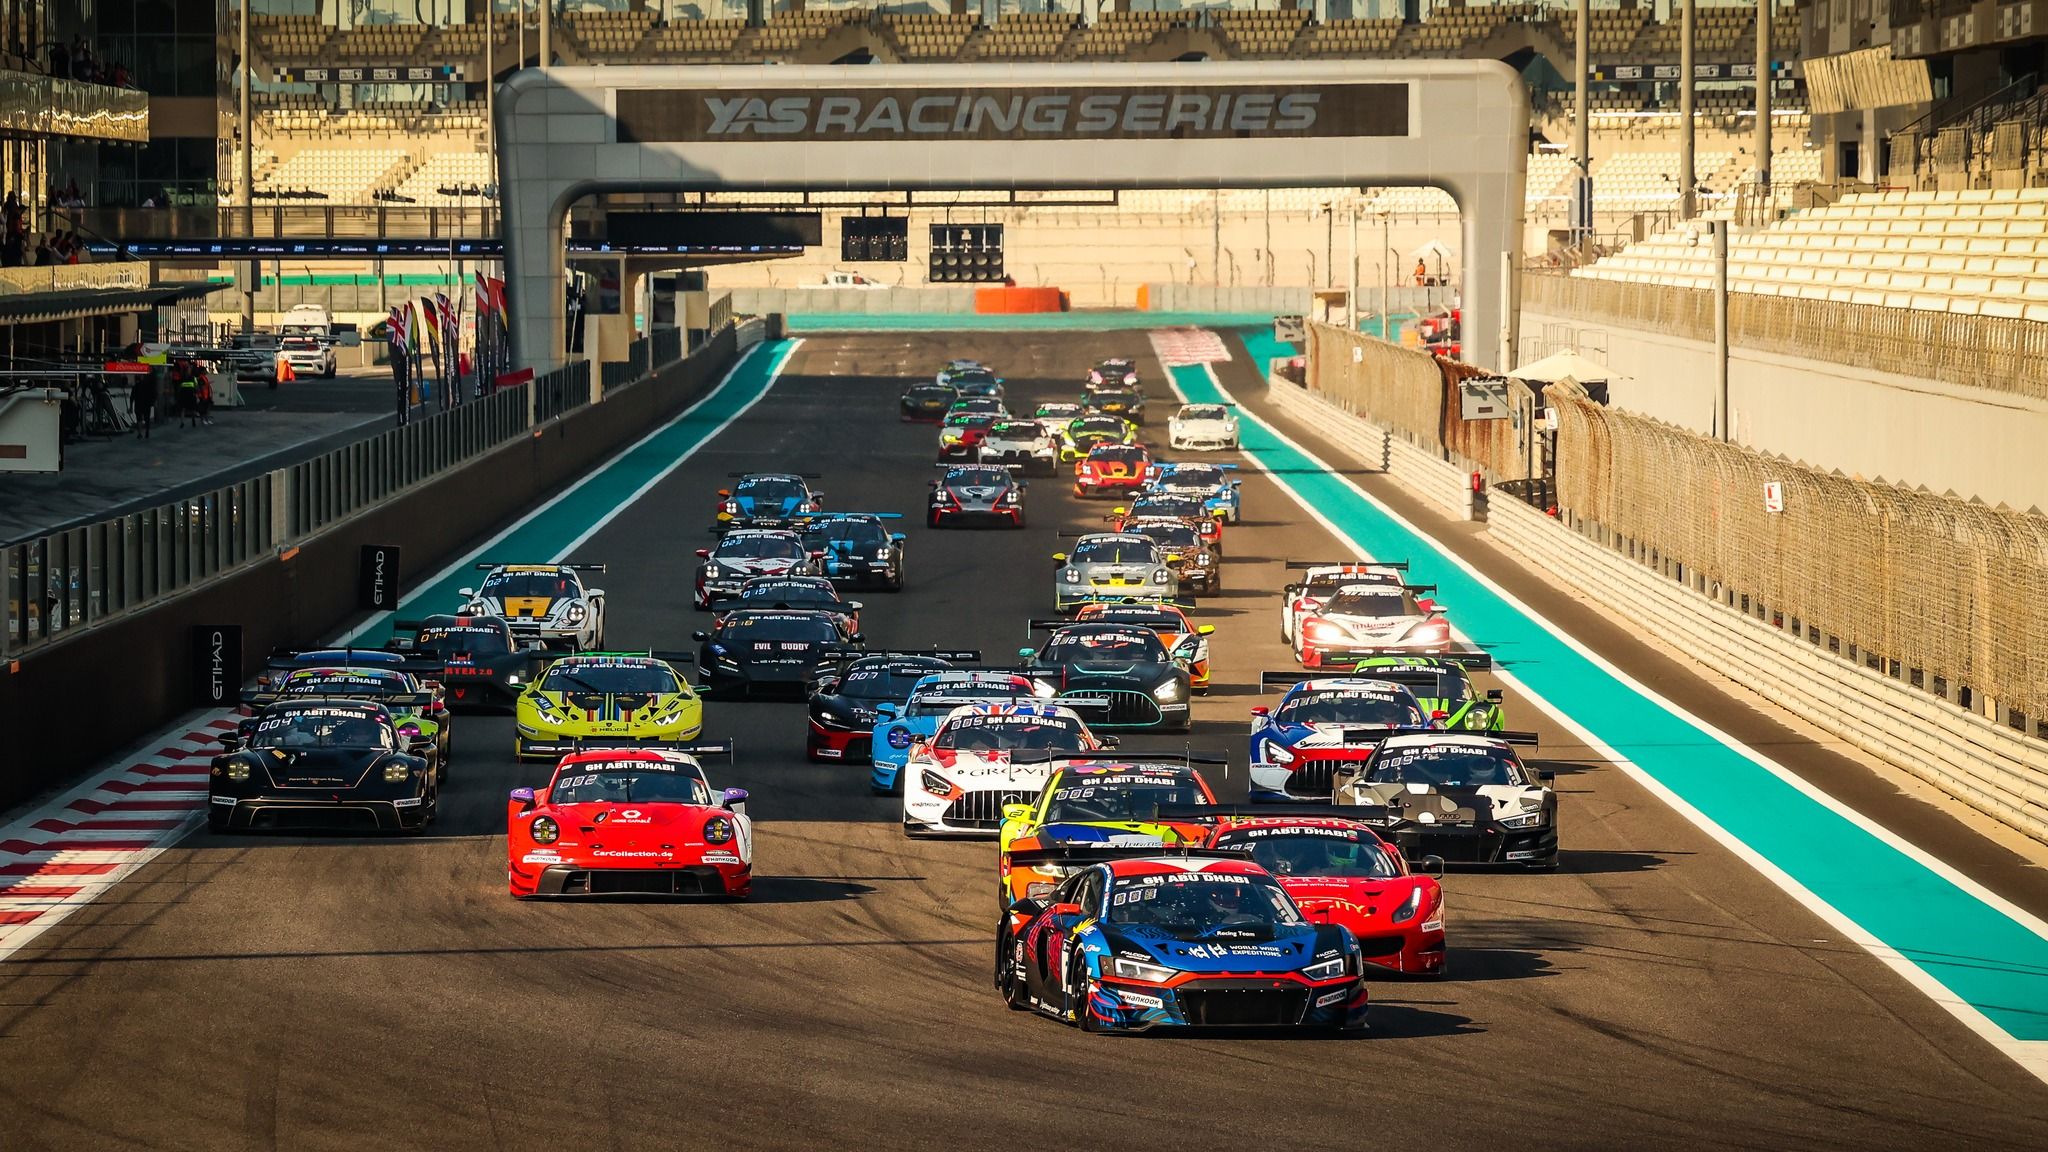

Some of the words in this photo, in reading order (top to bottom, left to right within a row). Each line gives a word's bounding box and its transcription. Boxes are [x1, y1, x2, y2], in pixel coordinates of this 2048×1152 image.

[703, 97, 811, 134] YAS
[815, 96, 1070, 133] RACING
[1077, 93, 1322, 131] SERIES
[374, 550, 384, 605] ETIHAD
[465, 626, 494, 634] DHABI
[1115, 635, 1145, 644] DHABI
[754, 642, 772, 650] EVIL
[781, 642, 810, 651] BUDDY
[212, 631, 223, 700] ETIHAD
[1416, 666, 1447, 674] DHABI
[348, 677, 382, 685] DHABI
[848, 672, 878, 681] 007
[977, 683, 1010, 691] DHABI
[1336, 691, 1358, 699] ABU
[1361, 692, 1394, 702] DHABI
[330, 710, 366, 719] DHABI
[258, 717, 292, 732] 004
[1005, 716, 1029, 724] ABU
[1032, 717, 1067, 729] DHABI
[1402, 748, 1420, 756] 6H
[1422, 747, 1447, 755] ABU
[1451, 748, 1487, 756] DHABI
[585, 763, 603, 771] 6H
[606, 762, 632, 770] ABU
[636, 763, 676, 772] DHABI
[1379, 756, 1413, 770] 009
[559, 775, 597, 789] 002
[1082, 777, 1100, 786] 6H
[1103, 776, 1131, 784] ABU
[1134, 776, 1176, 786] DHABI
[1056, 787, 1096, 801] 006
[1248, 829, 1267, 838] 6H
[1271, 828, 1300, 836] ABU
[1303, 828, 1347, 838] DHABI
[593, 850, 673, 858] CarCollection.de
[1143, 873, 1166, 884] 6H
[1168, 873, 1200, 883] ABU
[1202, 873, 1250, 885] DHABI
[1297, 900, 1371, 918] USCITY
[1231, 950, 1282, 958] EXPEDITIONS
[1125, 994, 1160, 1005] Hankook
